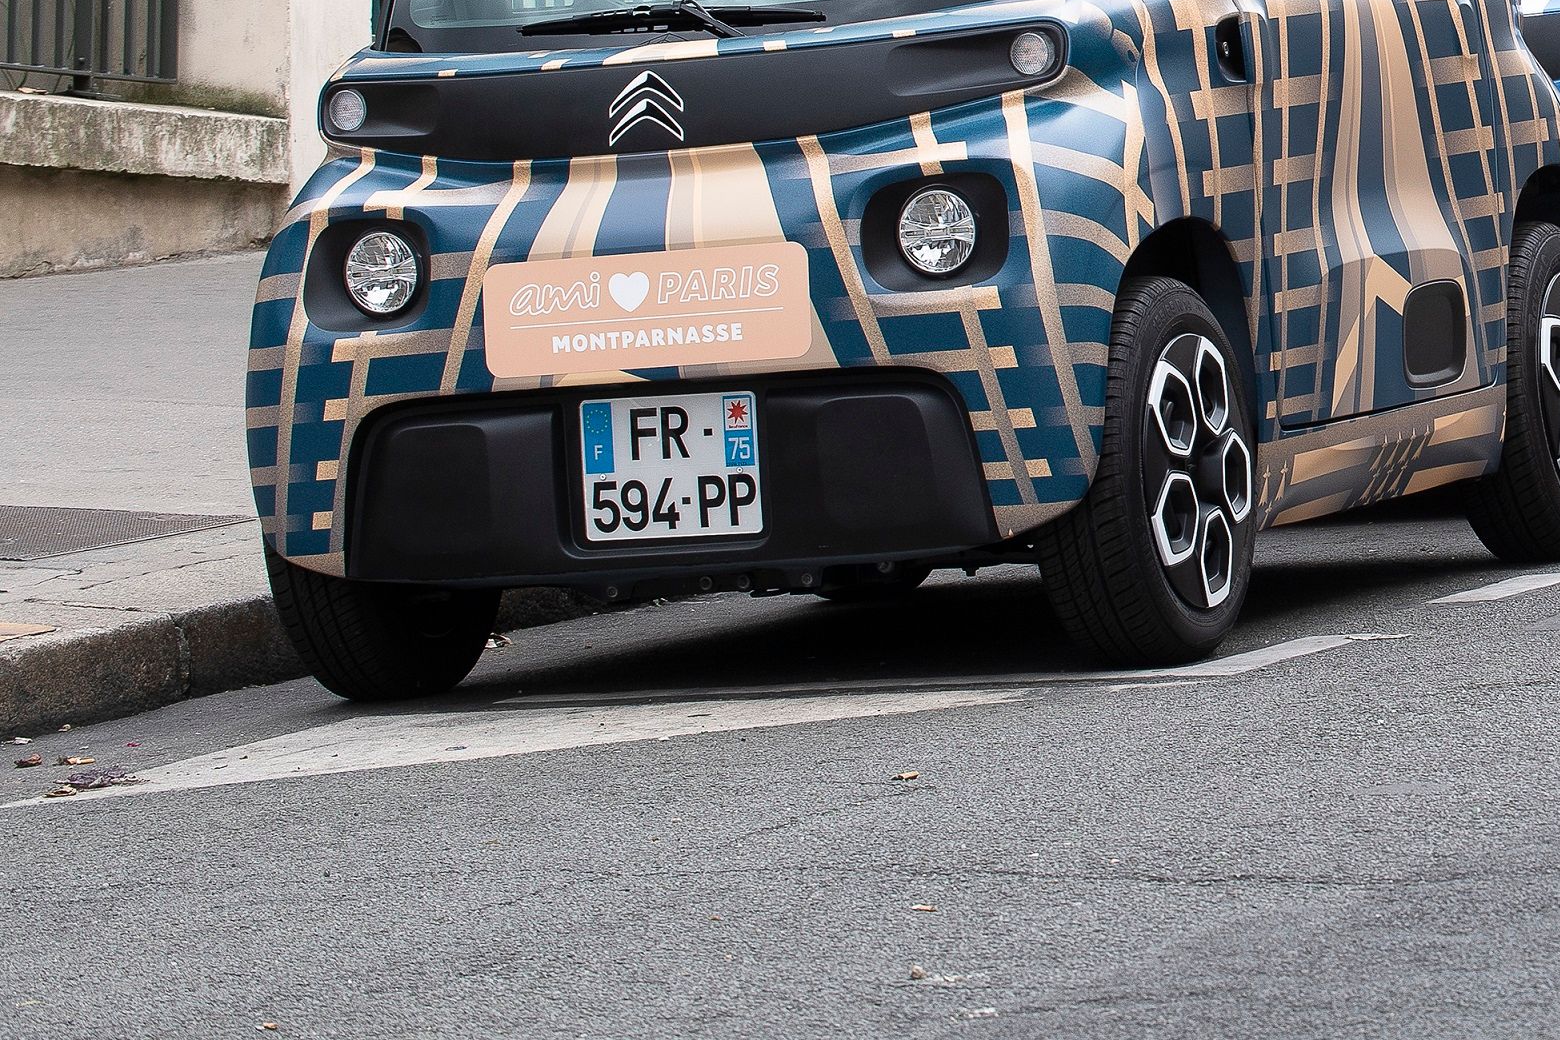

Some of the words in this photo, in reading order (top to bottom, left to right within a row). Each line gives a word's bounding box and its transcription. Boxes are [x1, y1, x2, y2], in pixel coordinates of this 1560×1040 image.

[509, 271, 600, 317] ami
[657, 264, 780, 304] PARIS
[552, 323, 743, 354] MONTPARNASSE
[594, 445, 603, 460] F
[728, 436, 750, 460] 75
